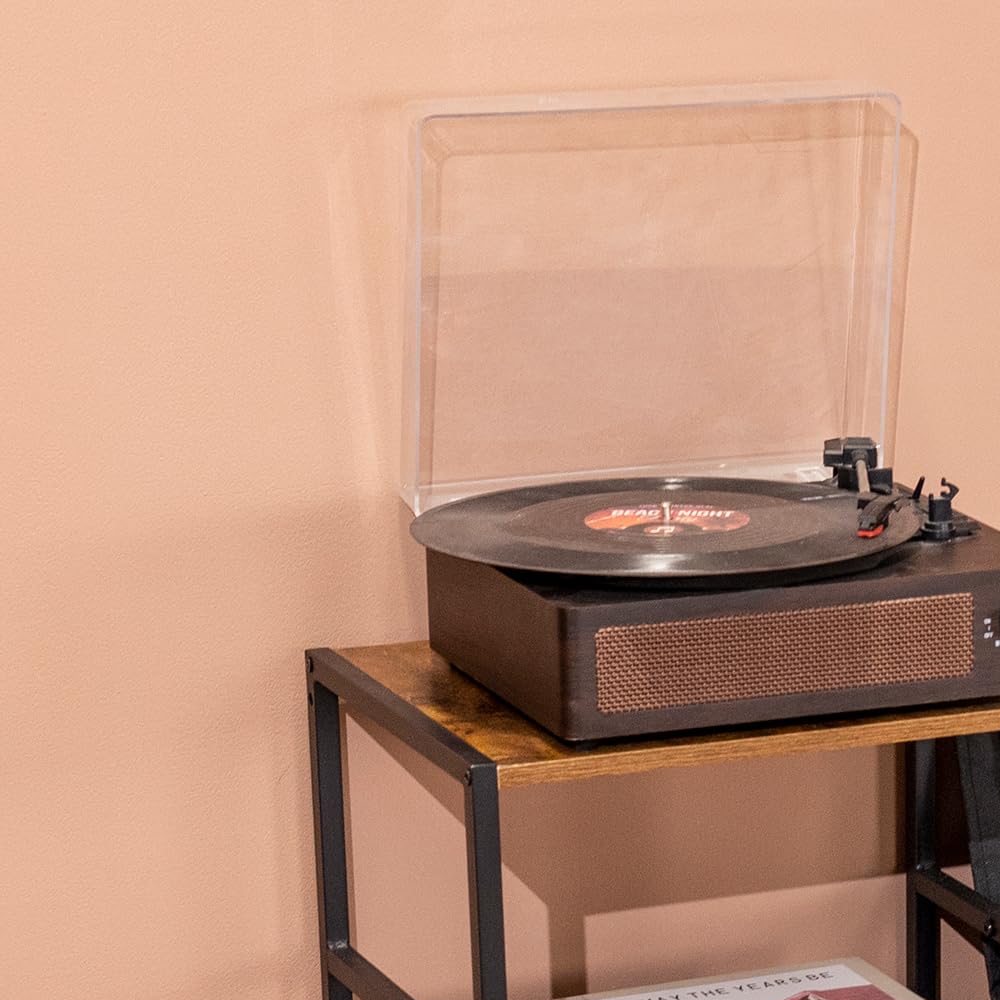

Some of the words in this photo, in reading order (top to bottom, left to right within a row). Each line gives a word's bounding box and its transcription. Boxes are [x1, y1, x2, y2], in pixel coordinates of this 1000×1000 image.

[678, 510, 736, 518] NIGHT
[687, 987, 730, 1000] THE
[732, 976, 802, 994] YEARS
[805, 971, 835, 983] BE
